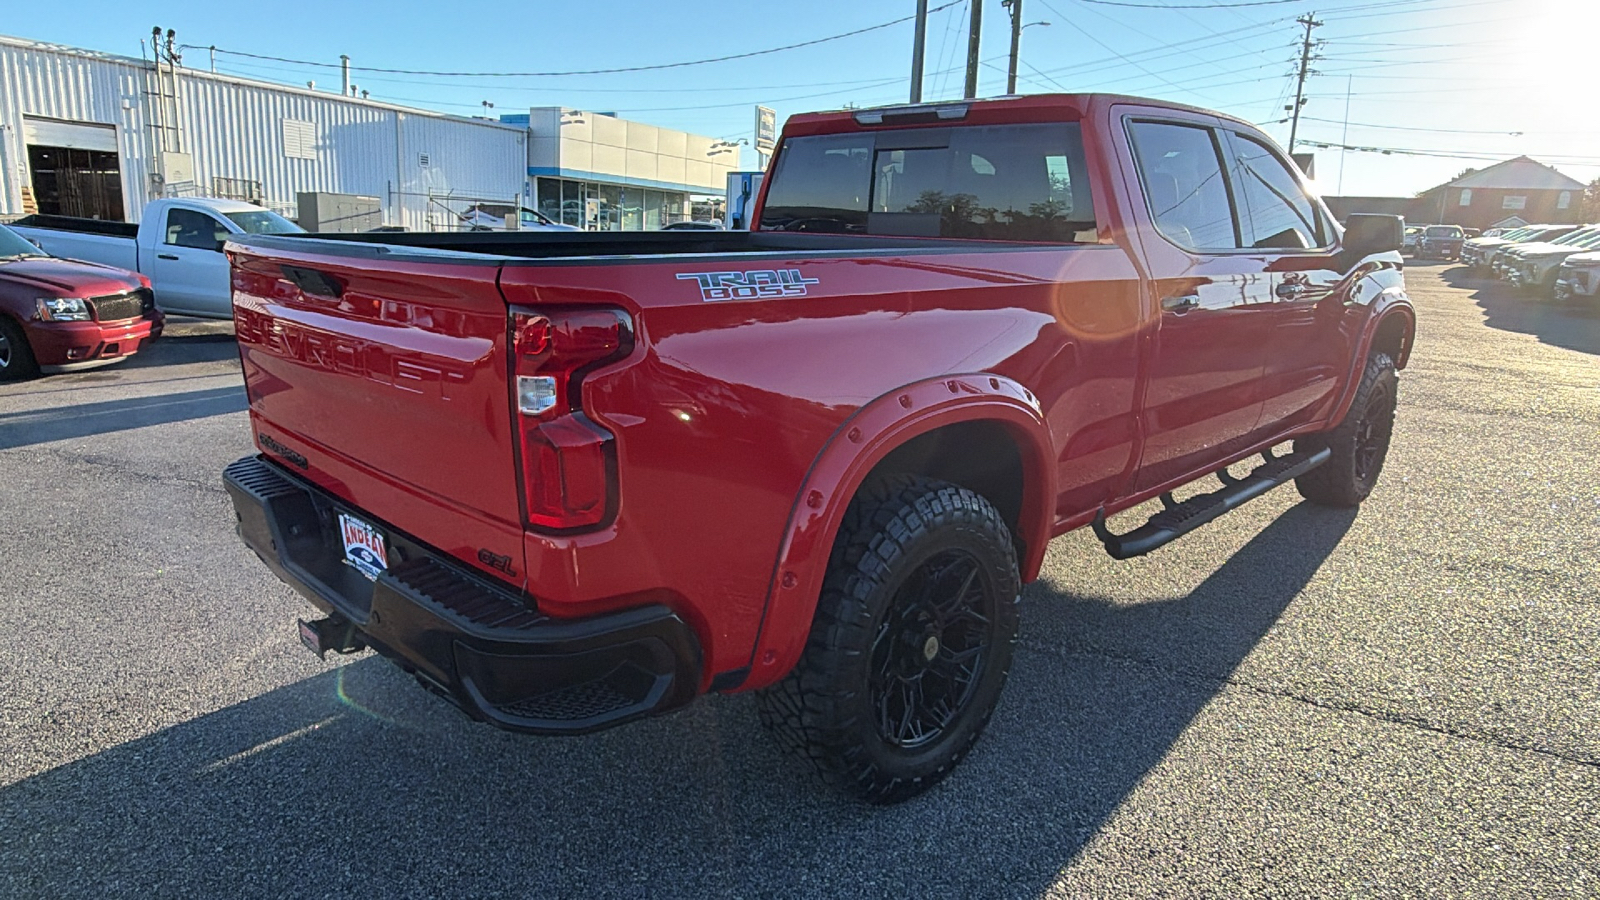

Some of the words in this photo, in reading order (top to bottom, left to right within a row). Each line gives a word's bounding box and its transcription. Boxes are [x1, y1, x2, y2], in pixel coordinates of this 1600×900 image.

[676, 269, 819, 288] TRAIL
[702, 285, 807, 302] BOSS
[344, 522, 388, 565] ANDEAN
